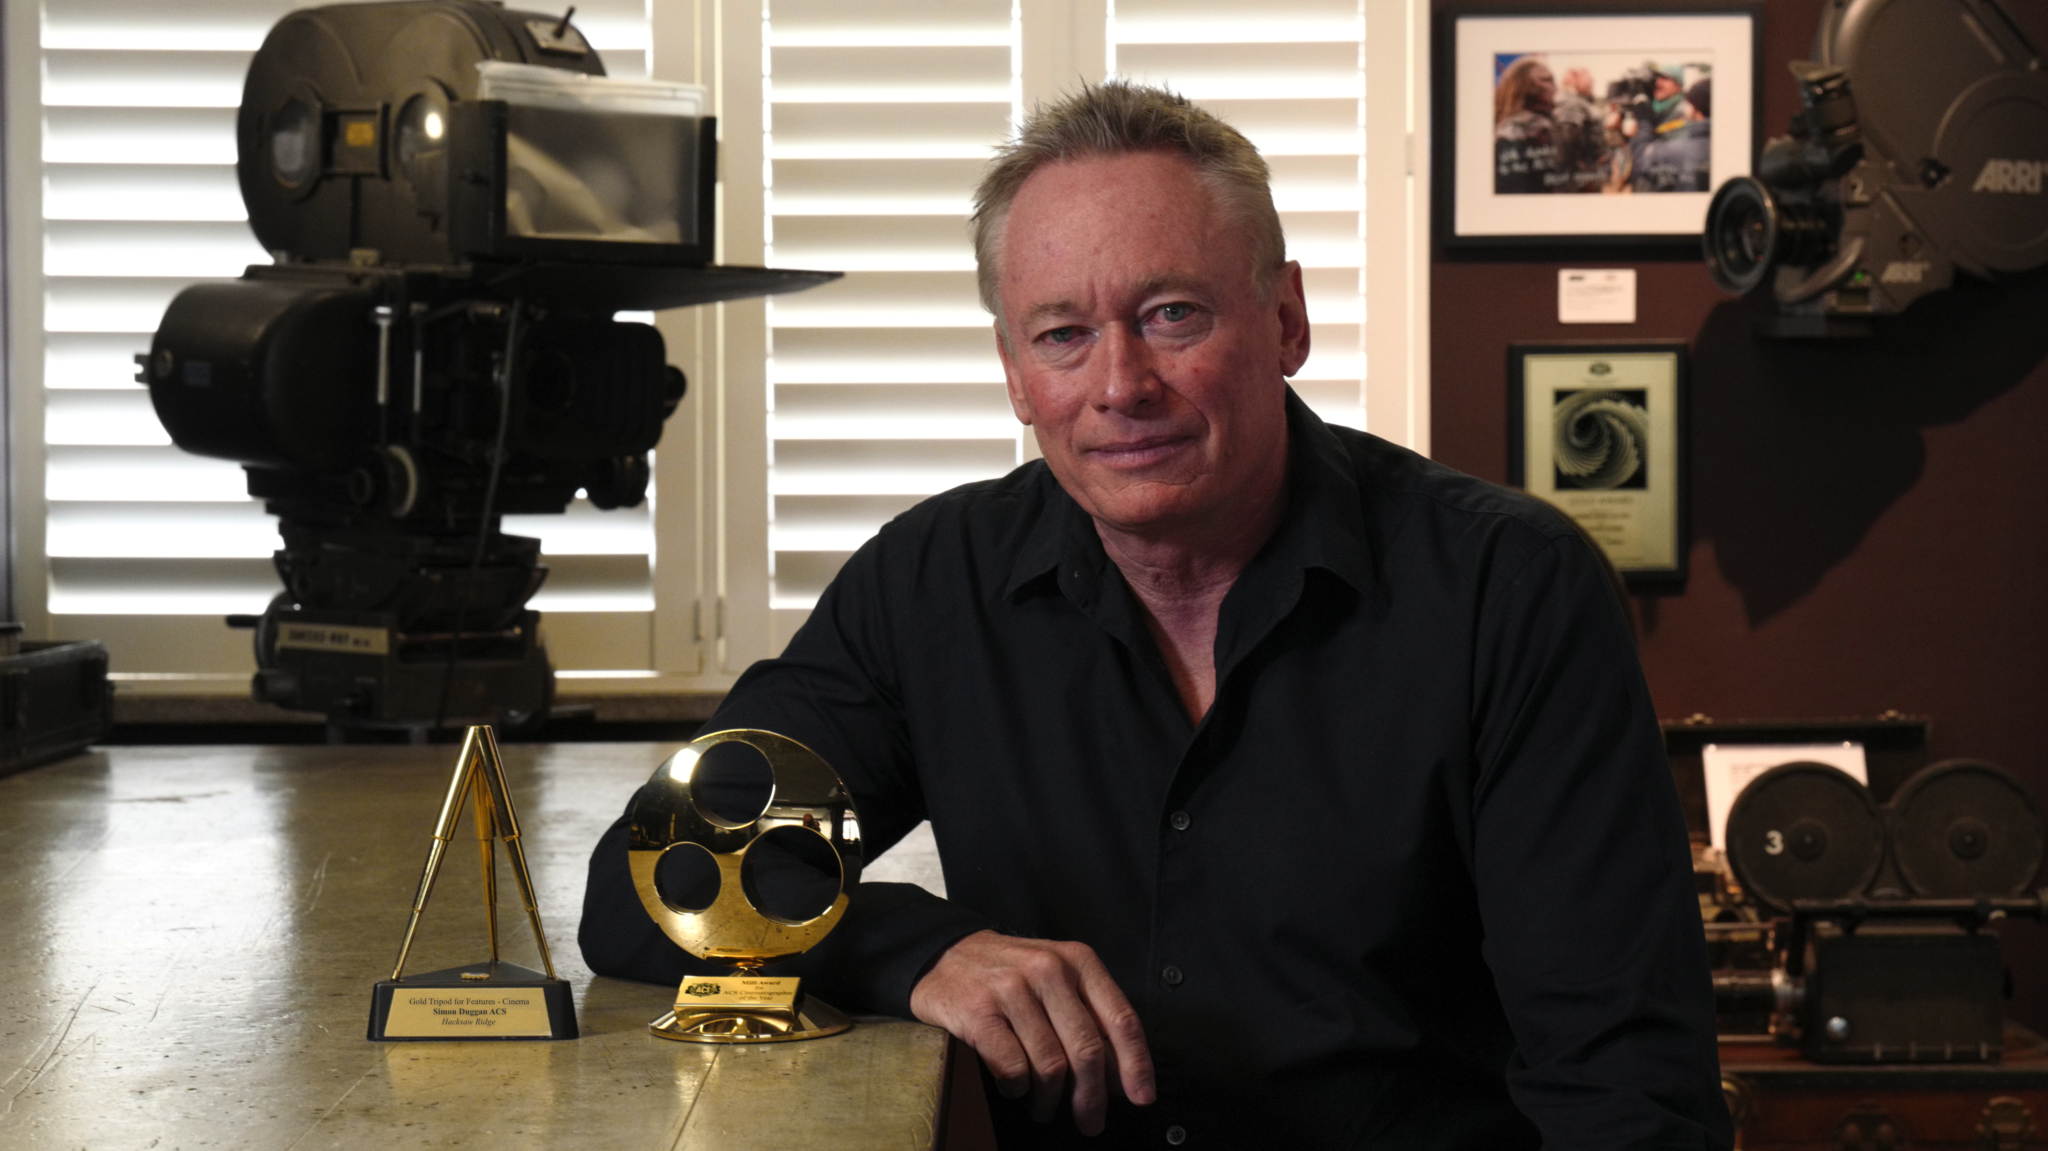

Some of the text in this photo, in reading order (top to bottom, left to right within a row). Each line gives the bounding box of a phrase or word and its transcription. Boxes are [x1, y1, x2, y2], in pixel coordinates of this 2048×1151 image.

[1972, 159, 2043, 193] ARRI
[1850, 174, 1870, 202] 2
[1764, 830, 1784, 855] 3
[428, 998, 452, 1007] Tripod
[458, 1008, 488, 1017] Duggan
[441, 1018, 496, 1027] Hacksaw Ridge
